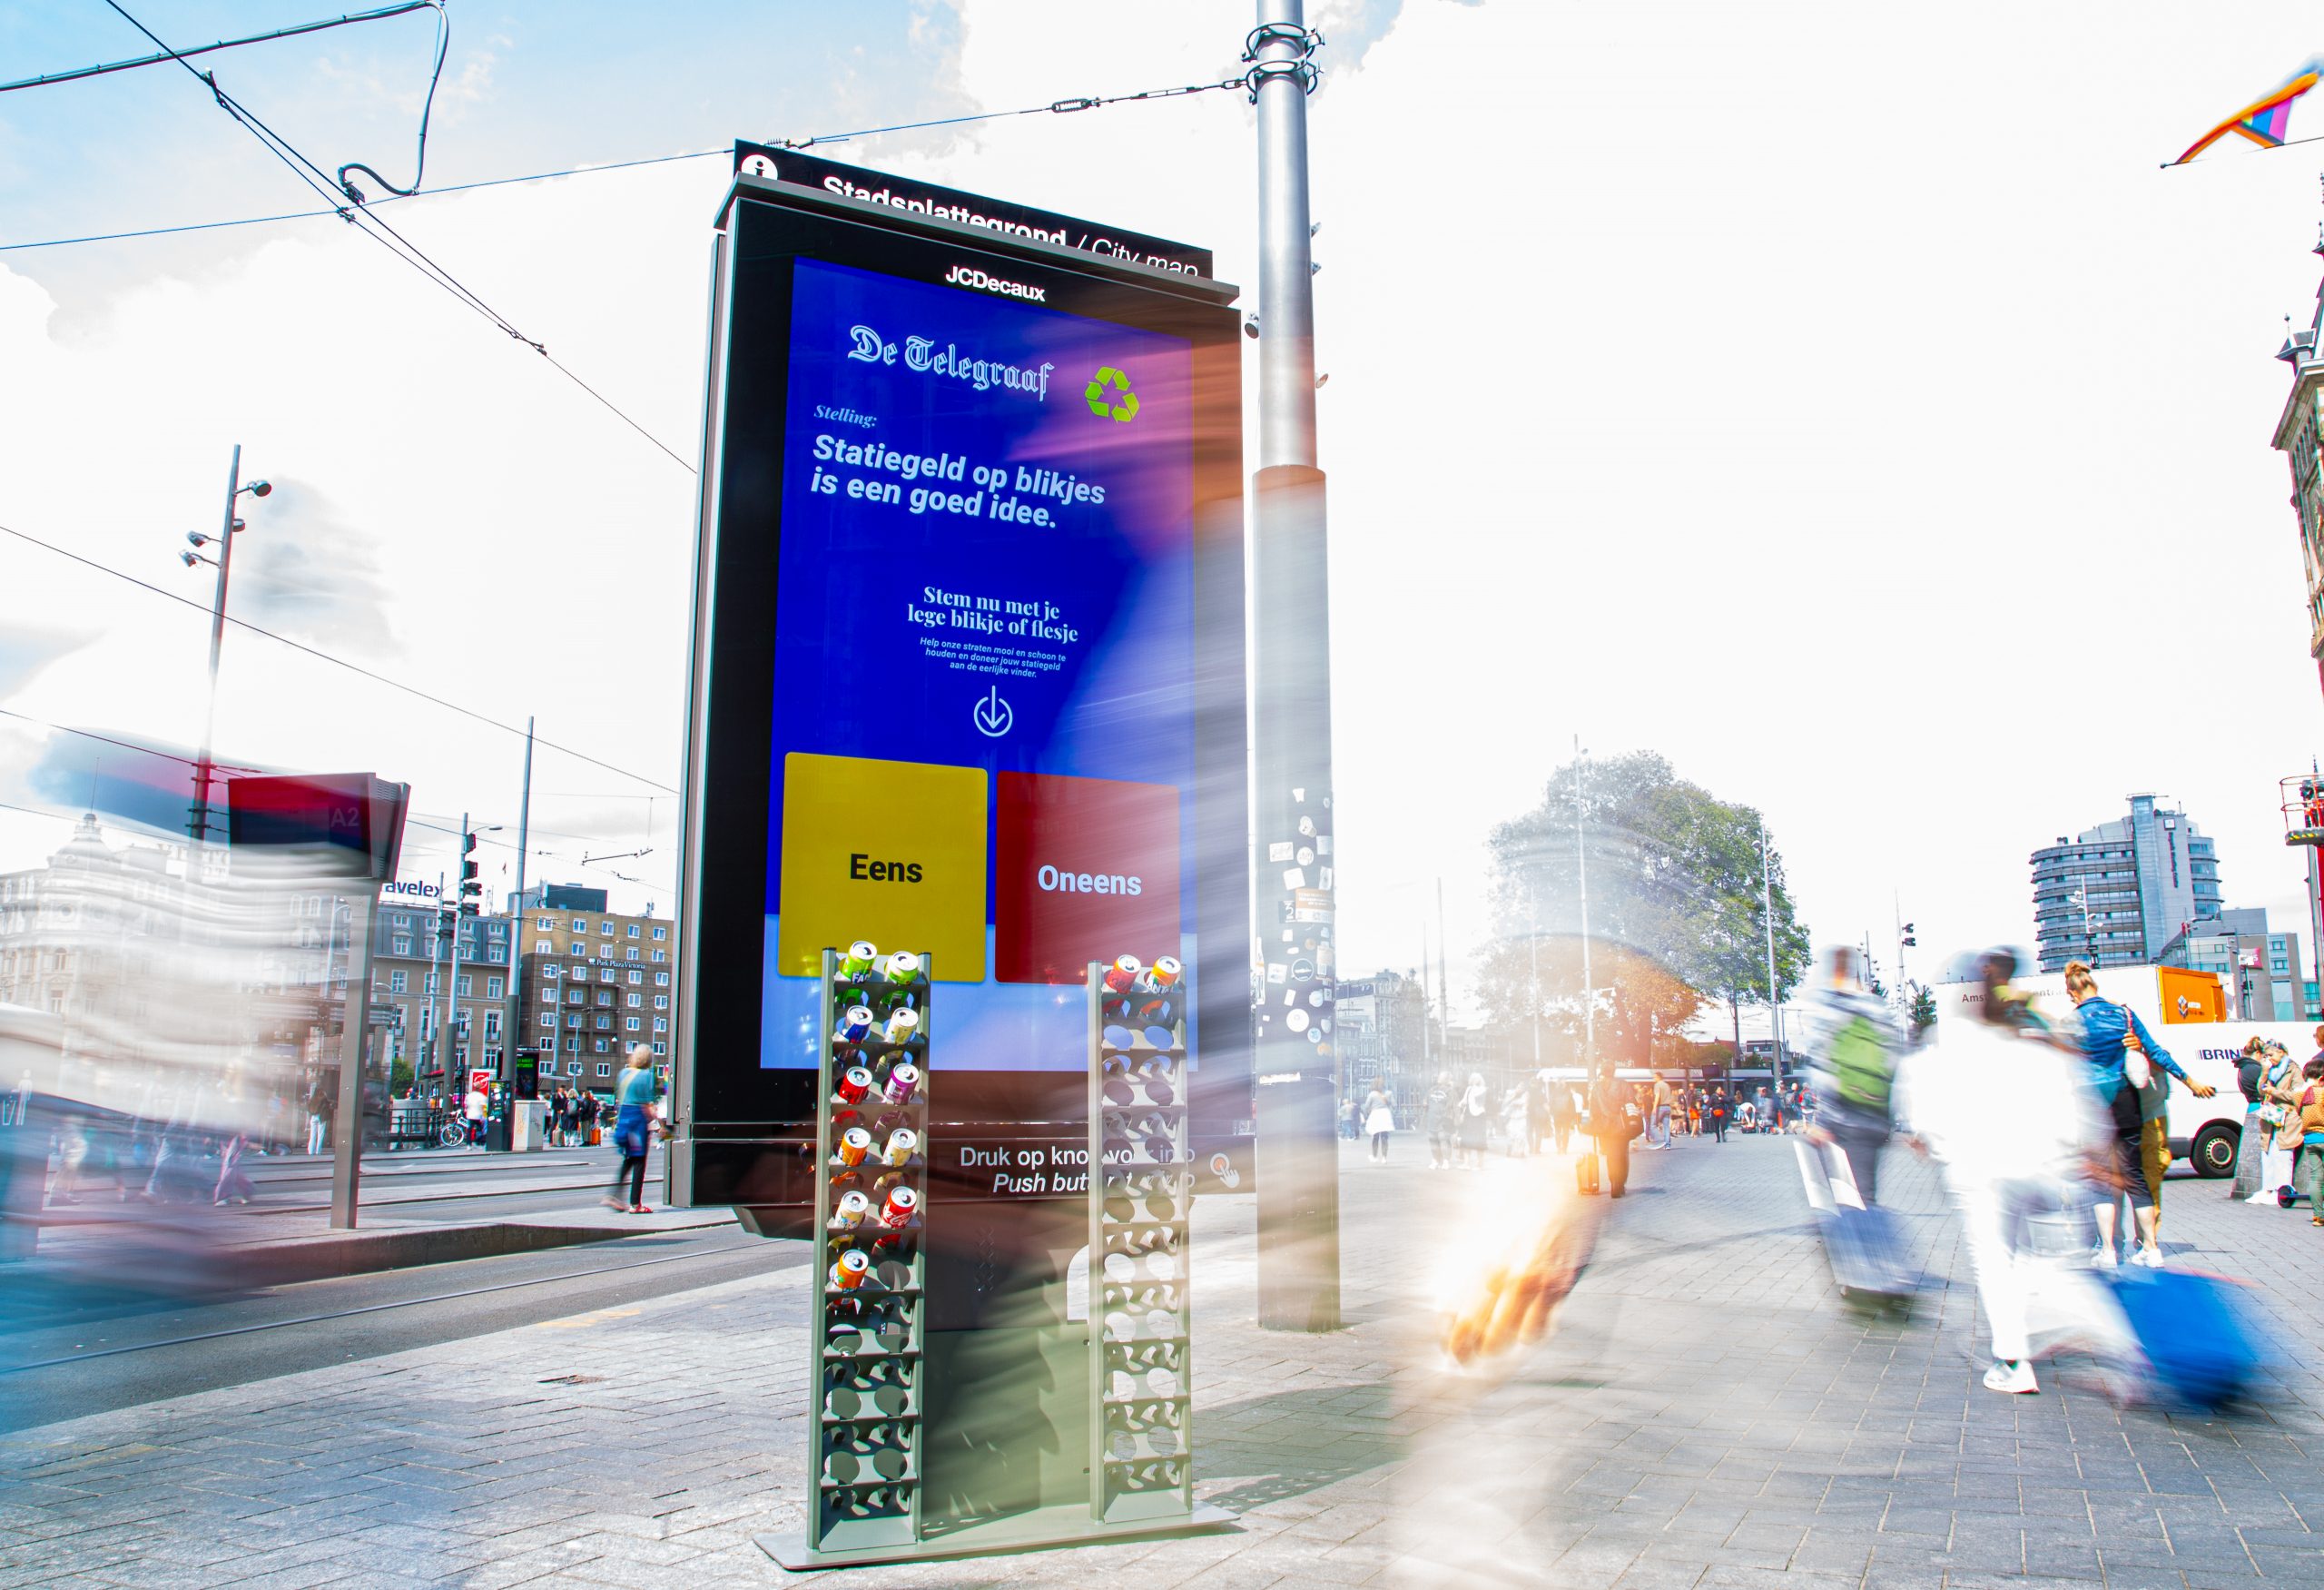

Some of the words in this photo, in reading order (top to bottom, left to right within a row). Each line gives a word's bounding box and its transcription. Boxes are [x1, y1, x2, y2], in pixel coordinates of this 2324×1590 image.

[945, 265, 1046, 301] JCDecaux
[847, 324, 899, 366] De
[904, 335, 1055, 402] Telegraaf
[813, 404, 878, 429] Stelling:
[812, 434, 967, 481] Statiegeld
[972, 466, 1007, 493] op
[1015, 465, 1106, 505] blikjes
[811, 466, 839, 494] is
[846, 479, 901, 504] een
[909, 487, 983, 517] goed
[989, 494, 1056, 528] idee.
[923, 586, 971, 608] Stem
[976, 596, 1001, 612] nu
[1005, 600, 1040, 617] met
[1043, 601, 1060, 622] je
[908, 603, 946, 627] lege
[950, 608, 1004, 635] blikje
[1008, 617, 1029, 636] of
[1031, 619, 1078, 645] flesje
[920, 637, 940, 647] Help
[940, 640, 961, 649] onze
[963, 642, 992, 653] straten
[993, 647, 1015, 656] mooi
[1015, 649, 1026, 657] en
[1027, 649, 1057, 661] schoon
[1058, 653, 1067, 662] te
[925, 647, 957, 659] houden
[958, 652, 969, 660] en
[970, 652, 999, 664] doneer
[1000, 656, 1019, 667] jouw
[1021, 659, 1061, 672] statiegeld
[950, 661, 965, 670] aan
[967, 662, 978, 671] de
[979, 665, 1009, 676] eerlijke
[1010, 667, 1038, 678] vinder.
[330, 806, 360, 828] A2
[850, 854, 923, 883] Eens
[1038, 864, 1143, 896] Oneens
[384, 880, 440, 898] avele
[596, 958, 608, 967] Park
[2202, 1049, 2243, 1061] BRIN
[960, 1146, 1010, 1167] Druk
[1017, 1149, 1044, 1170] op
[1050, 1146, 1088, 1165] kno
[992, 1171, 1045, 1193] Push
